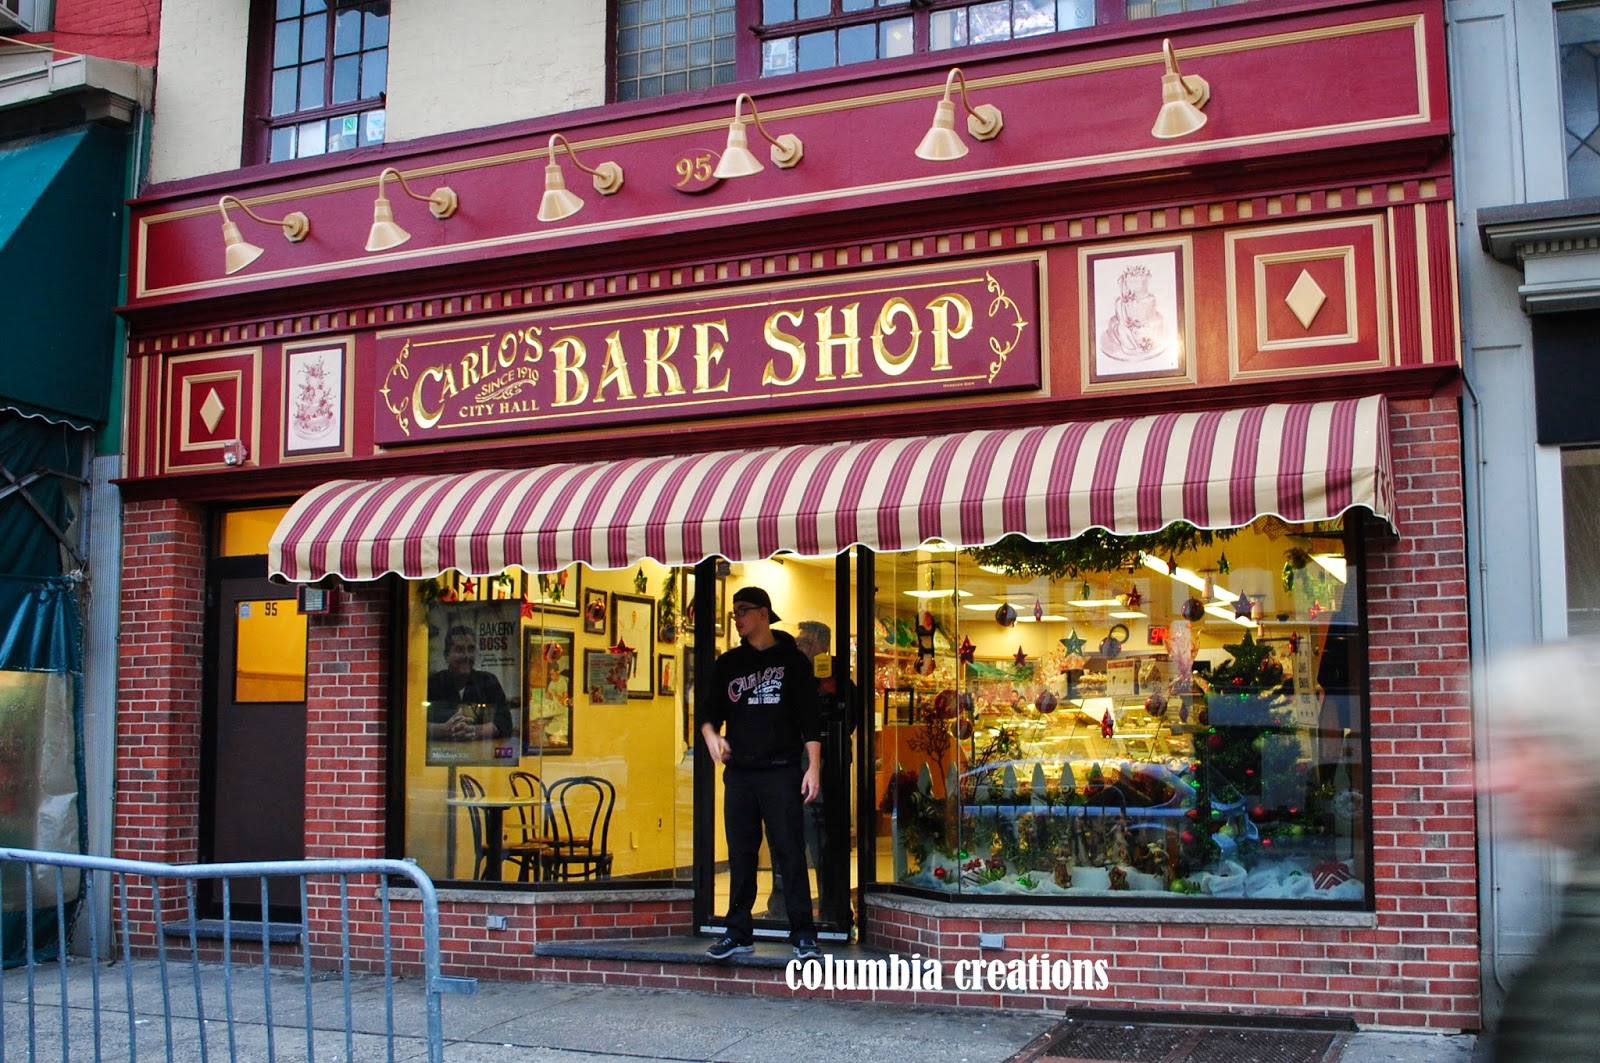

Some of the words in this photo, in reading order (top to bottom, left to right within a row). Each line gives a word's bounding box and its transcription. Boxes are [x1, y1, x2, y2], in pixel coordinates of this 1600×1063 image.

[676, 154, 712, 187] 95
[412, 326, 543, 429] CARLO'S
[549, 318, 731, 408] BAKE
[762, 293, 974, 387] SHOP
[481, 370, 515, 396] SINCE
[517, 366, 540, 381] 1910
[459, 403, 495, 418] CITY
[500, 399, 540, 414] HALL
[265, 602, 278, 616] 95
[479, 621, 516, 637] BAKERY
[479, 636, 508, 651] BOSS
